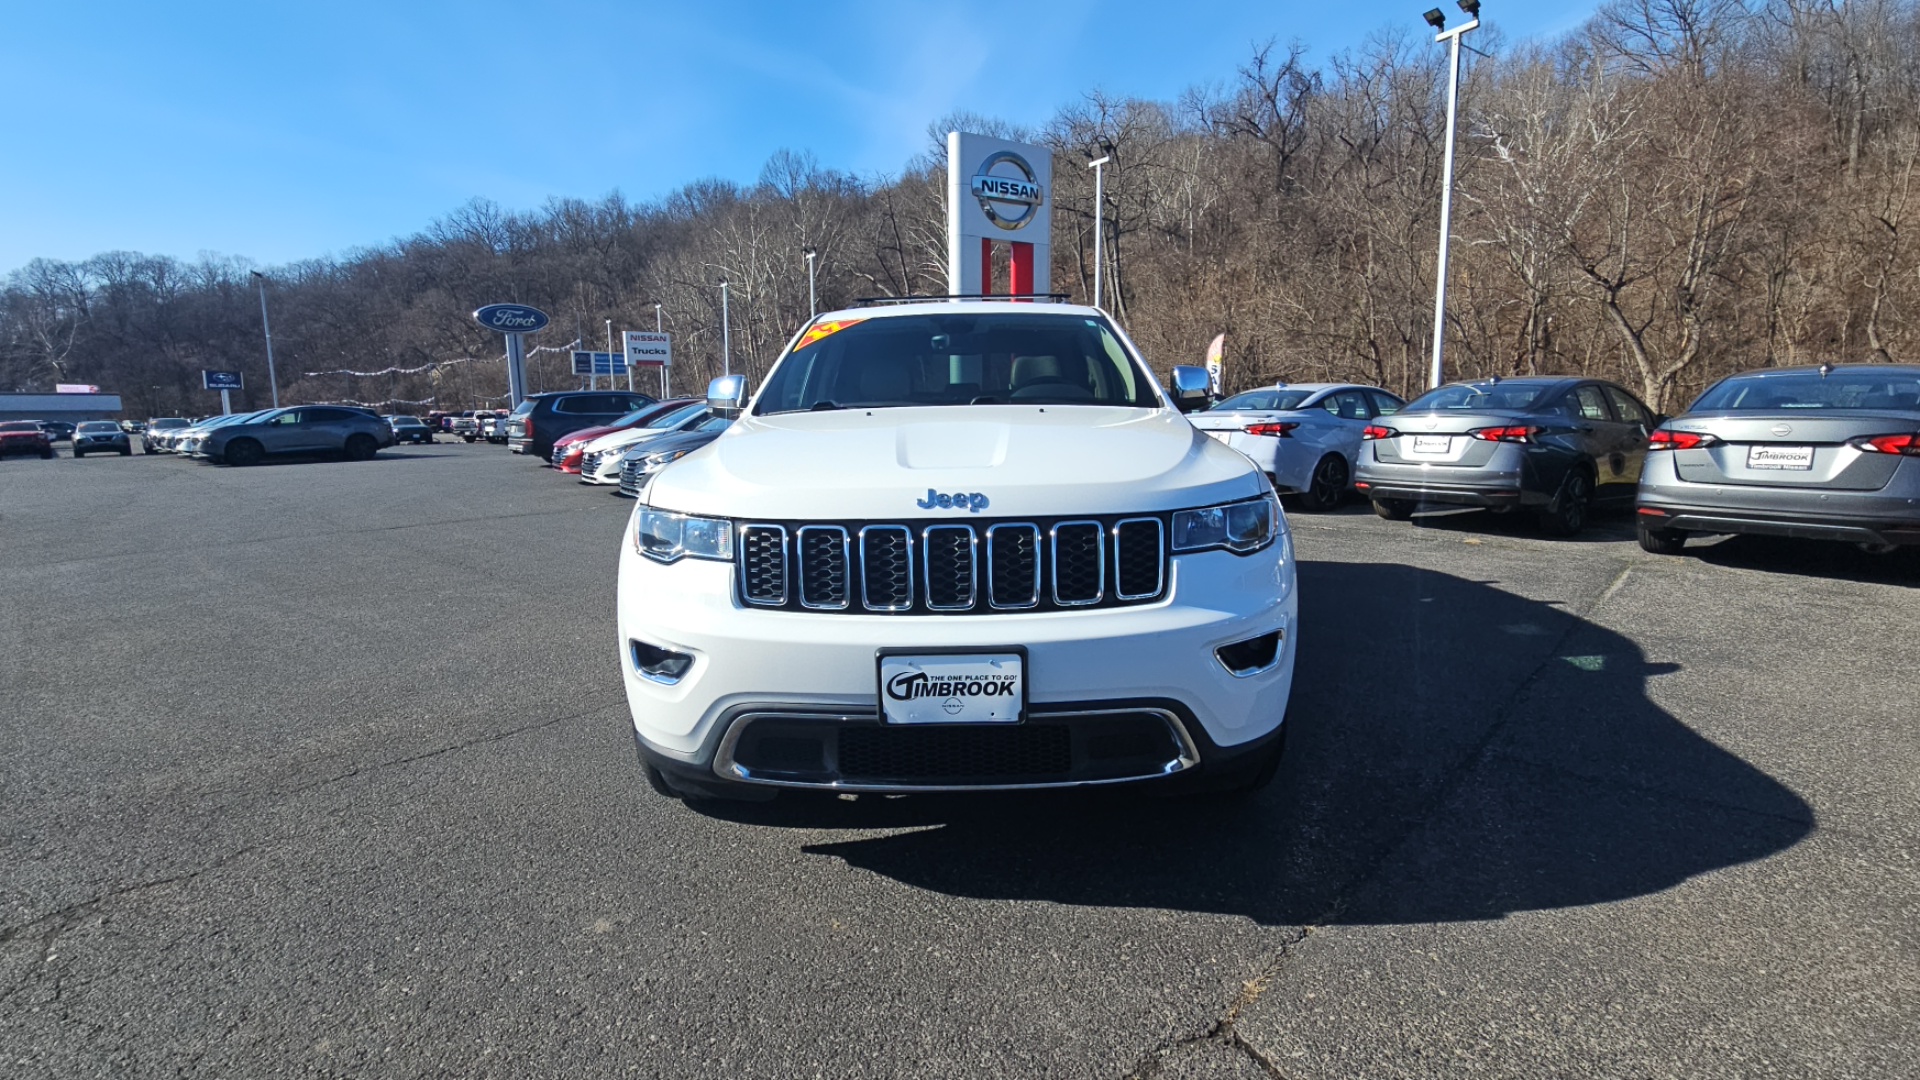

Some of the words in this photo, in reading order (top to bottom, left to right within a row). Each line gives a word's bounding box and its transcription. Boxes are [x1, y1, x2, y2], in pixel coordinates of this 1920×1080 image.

[981, 179, 1039, 200] NISSAN
[493, 309, 535, 327] Ford
[630, 334, 667, 342] NISSAN
[632, 347, 667, 355] Trucks
[917, 488, 990, 513] Jeep
[887, 671, 1017, 701] TIMBROOK
